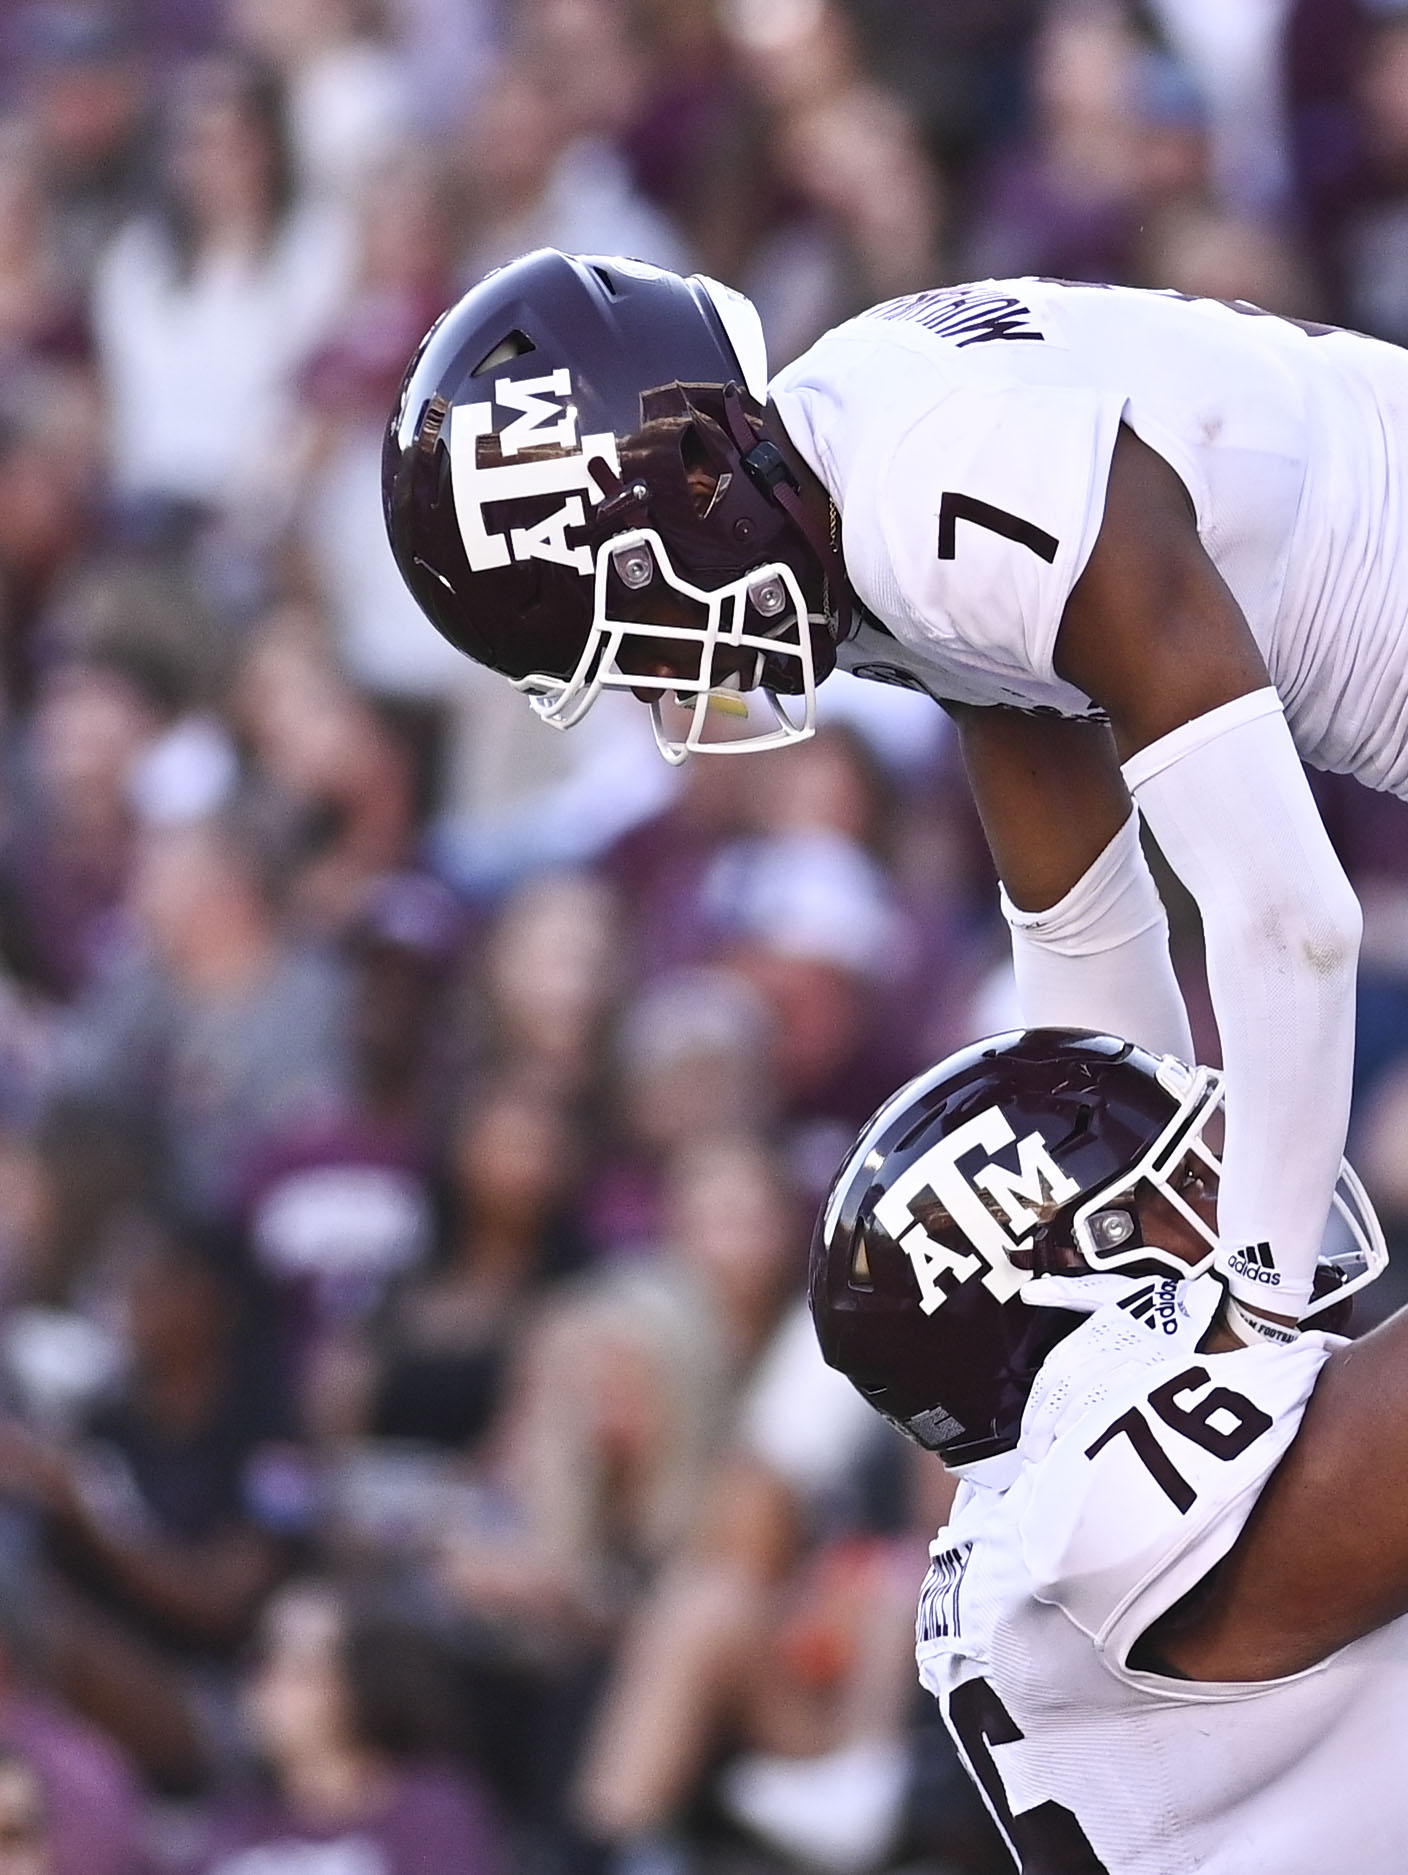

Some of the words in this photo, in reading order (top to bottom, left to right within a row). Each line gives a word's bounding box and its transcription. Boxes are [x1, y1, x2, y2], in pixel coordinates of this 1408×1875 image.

[937, 491, 1059, 564] 7
[1228, 1255, 1281, 1286] adidas
[1155, 1279, 1178, 1335] adidas
[1085, 1366, 1272, 1514] 76
